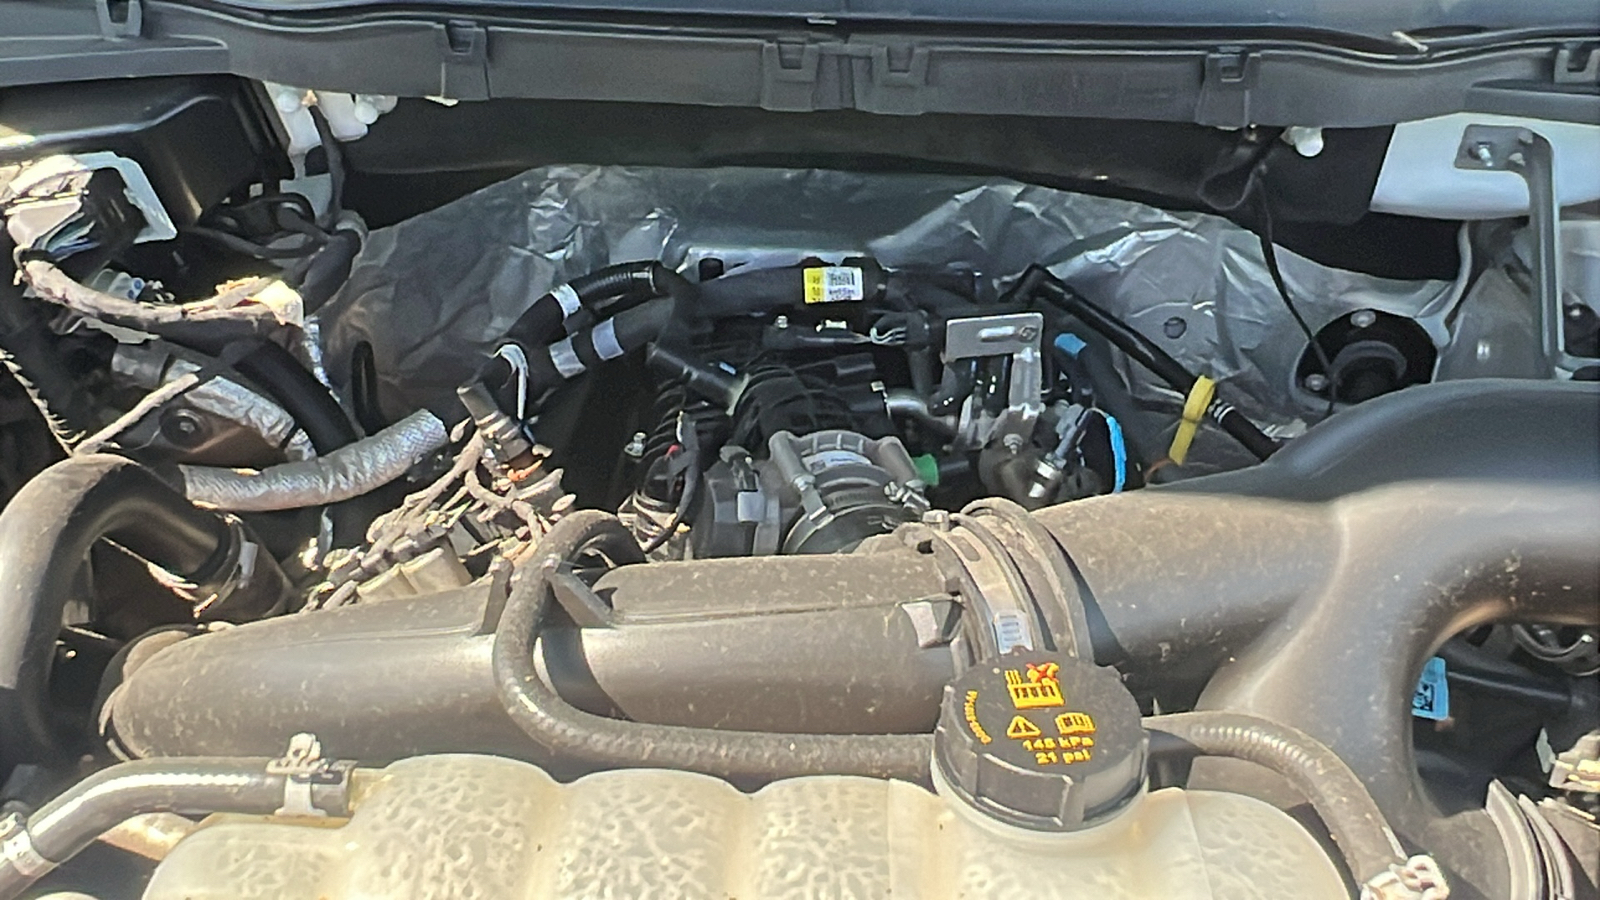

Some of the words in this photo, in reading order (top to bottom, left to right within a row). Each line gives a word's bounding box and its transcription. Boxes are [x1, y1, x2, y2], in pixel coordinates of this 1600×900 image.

[1058, 736, 1093, 749] kPa
[1035, 751, 1058, 764] 21
[1062, 748, 1091, 764] psi
